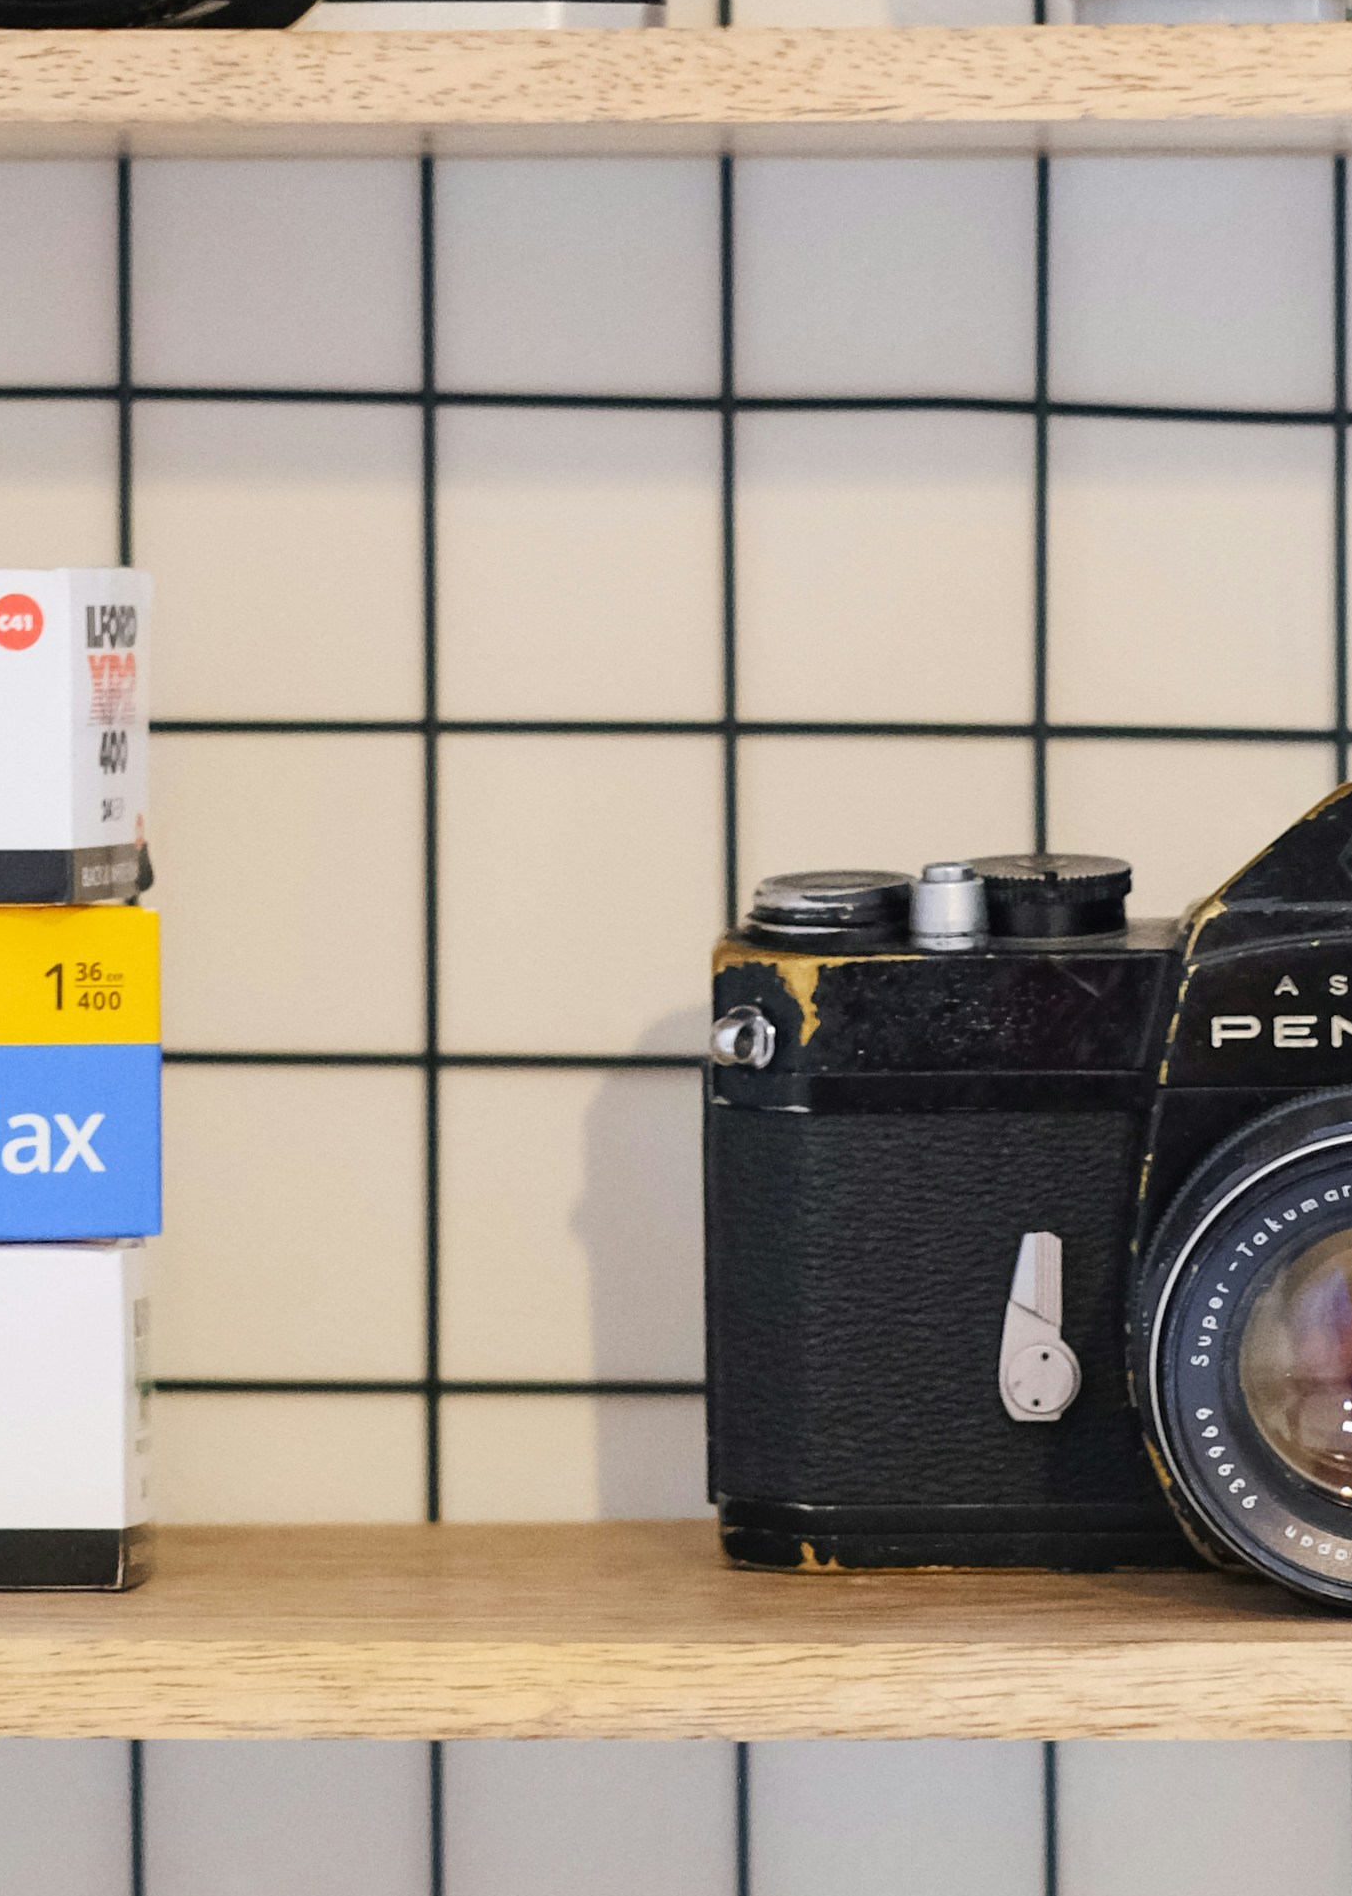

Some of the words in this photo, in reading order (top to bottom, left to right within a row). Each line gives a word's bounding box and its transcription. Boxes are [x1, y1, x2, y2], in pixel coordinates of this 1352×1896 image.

[74, 961, 103, 982] 36
[44, 963, 63, 1011] 1
[76, 990, 122, 1011] 400
